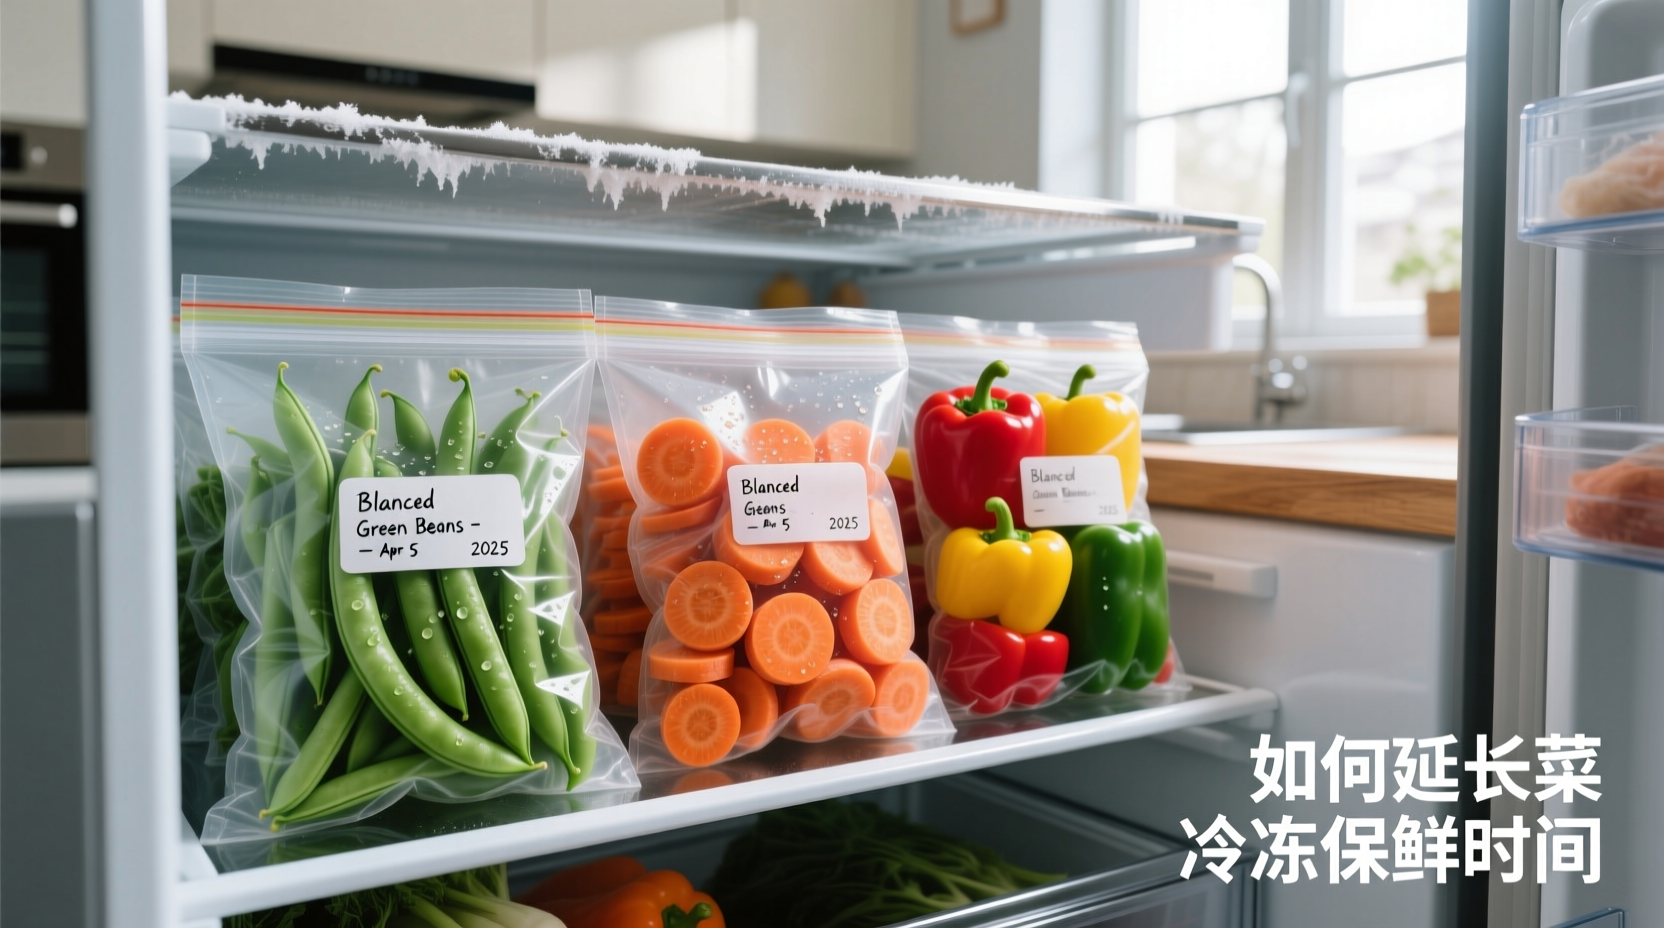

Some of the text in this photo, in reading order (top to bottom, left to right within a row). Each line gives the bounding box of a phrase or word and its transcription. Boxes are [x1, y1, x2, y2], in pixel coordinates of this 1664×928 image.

[741, 474, 799, 495] Blanced
[356, 488, 435, 512] Blanced
[357, 520, 408, 537] Green
[416, 517, 464, 534] Beans
[782, 518, 790, 531] 5
[829, 516, 858, 530] 2025
[380, 543, 403, 561] Apr
[410, 543, 418, 557] 5
[471, 541, 508, 556] 2025
